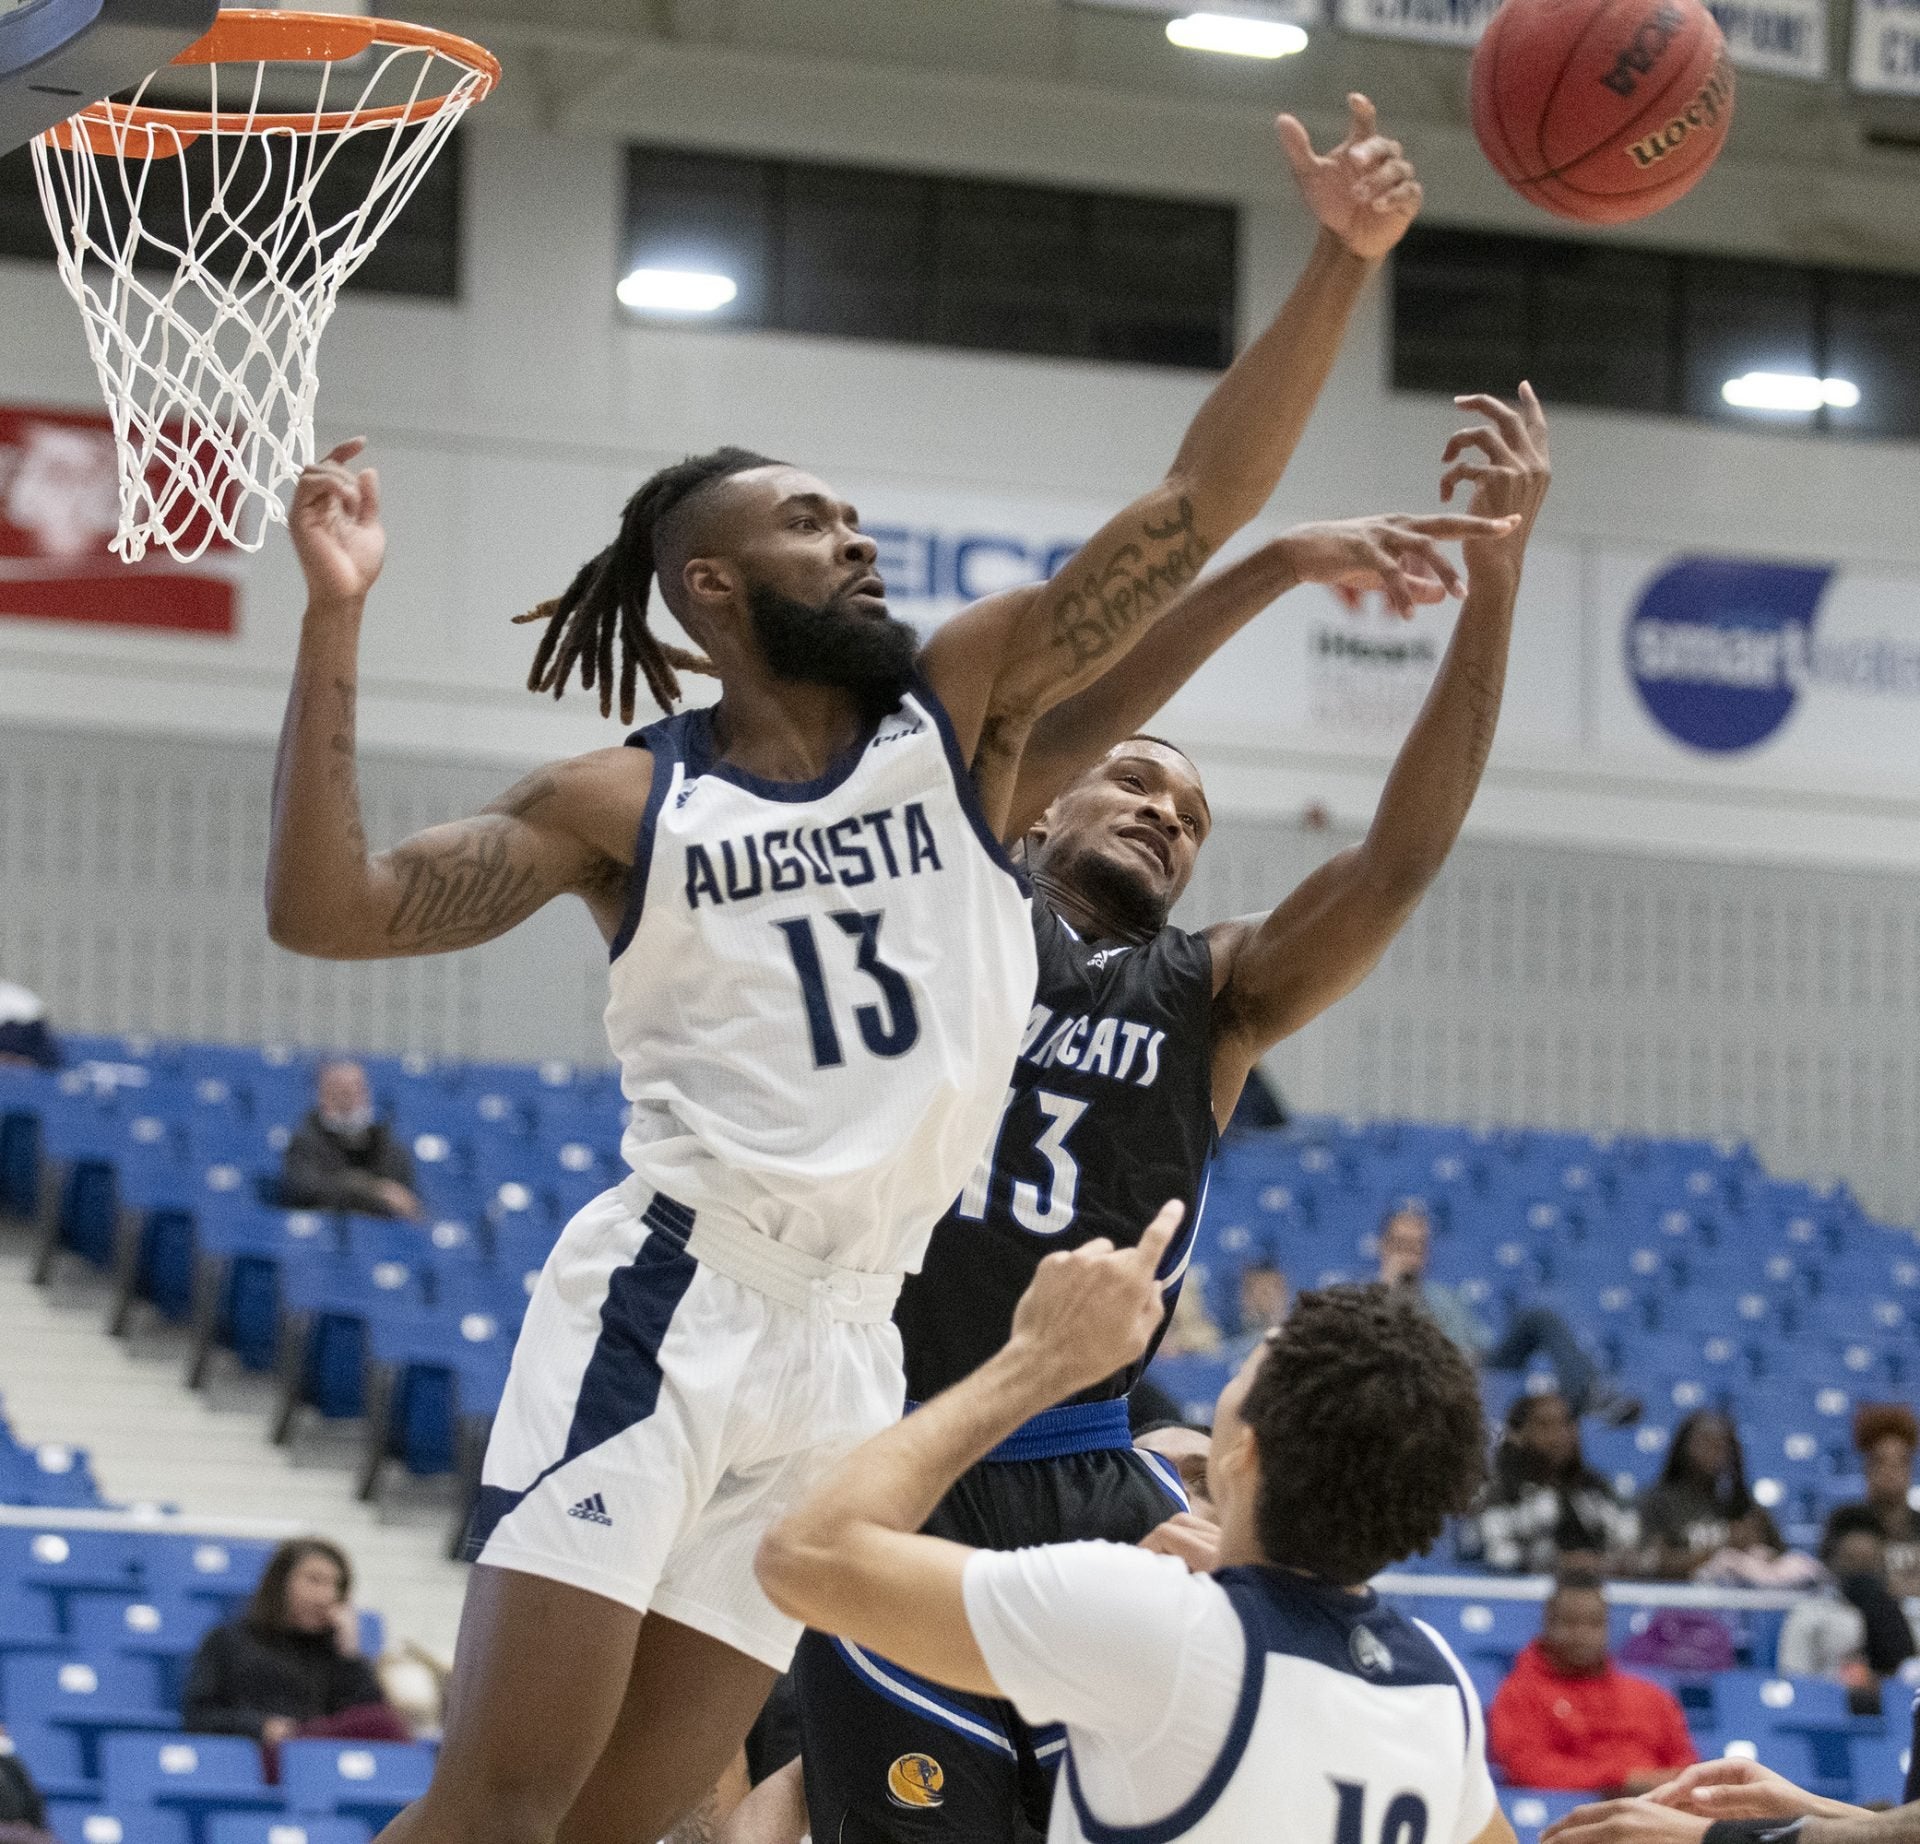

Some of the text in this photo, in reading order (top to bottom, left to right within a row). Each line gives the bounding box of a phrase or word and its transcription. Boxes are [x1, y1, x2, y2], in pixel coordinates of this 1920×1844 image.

[685, 802, 943, 909] AUGUSTA
[768, 907, 921, 1071] 13
[567, 1508, 613, 1527] adidas
